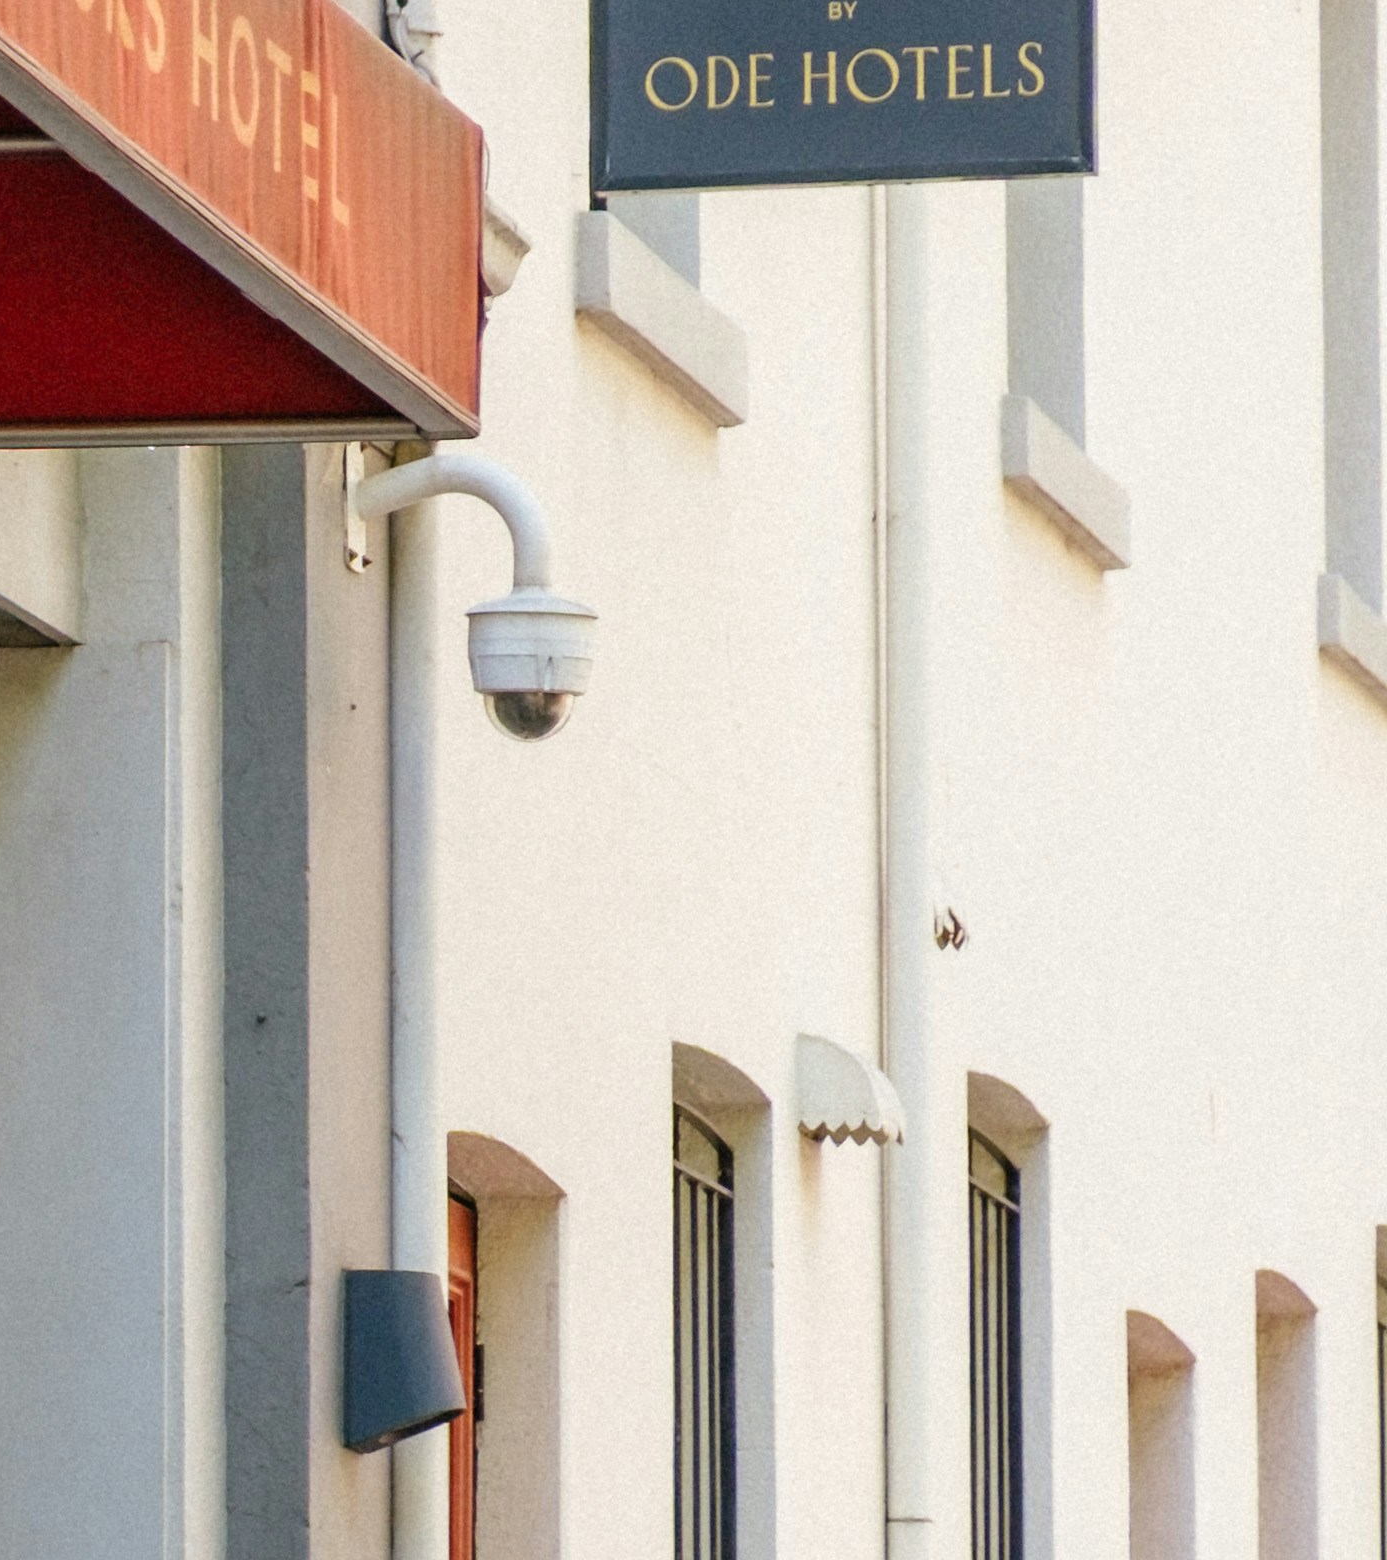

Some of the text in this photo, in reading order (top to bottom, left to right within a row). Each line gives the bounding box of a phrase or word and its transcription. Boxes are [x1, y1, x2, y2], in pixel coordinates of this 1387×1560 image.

[828, 1, 857, 20] BY
[644, 42, 1046, 111] ODE HOTELS
